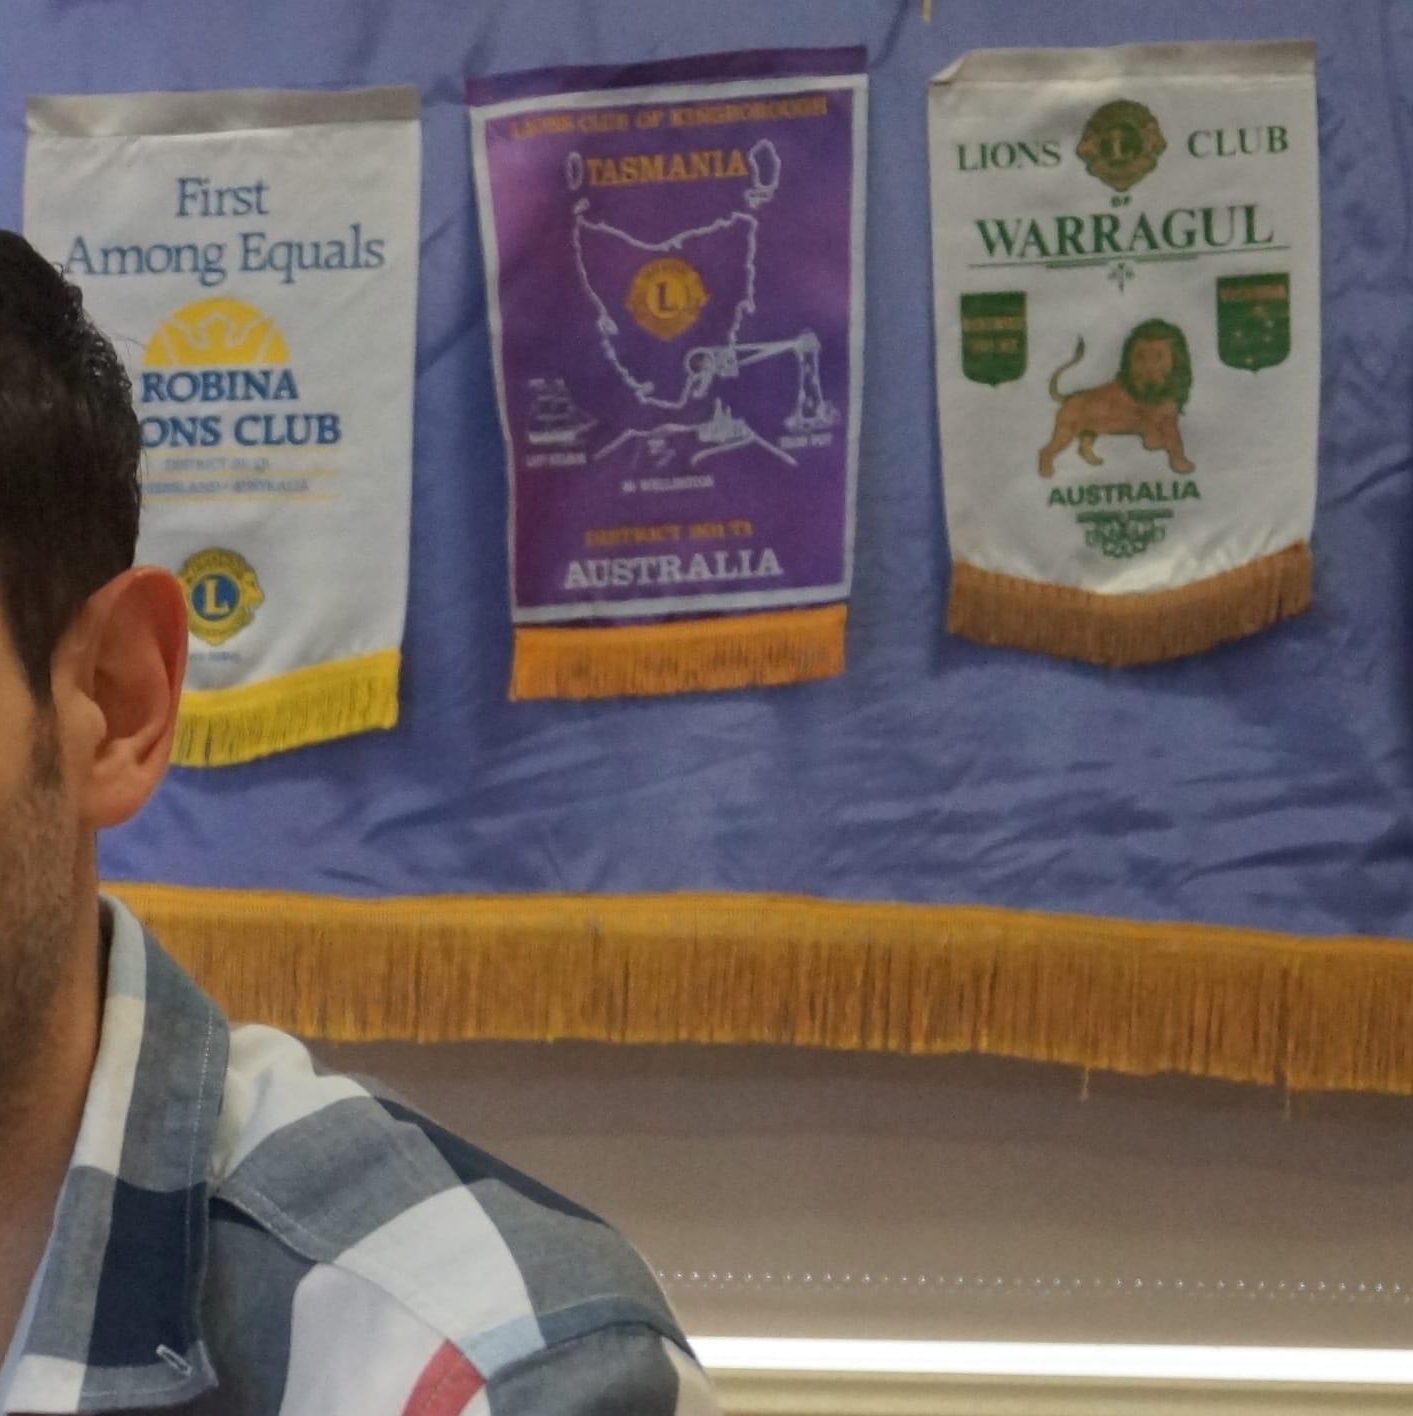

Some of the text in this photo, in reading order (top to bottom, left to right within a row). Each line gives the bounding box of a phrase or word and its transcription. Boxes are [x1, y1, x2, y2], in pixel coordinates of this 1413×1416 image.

[956, 140, 1062, 172] LIONS
[1187, 125, 1289, 158] CLUB
[586, 148, 749, 187] TASMANIA
[175, 177, 270, 218] First
[976, 203, 1274, 259] WARRAGUL
[64, 223, 385, 287] Among Equals
[141, 369, 300, 402] ROBINA
[233, 413, 342, 447] CLUB
[1048, 480, 1202, 507] AUSTRALIA
[564, 547, 785, 591] AUSTRALIA
